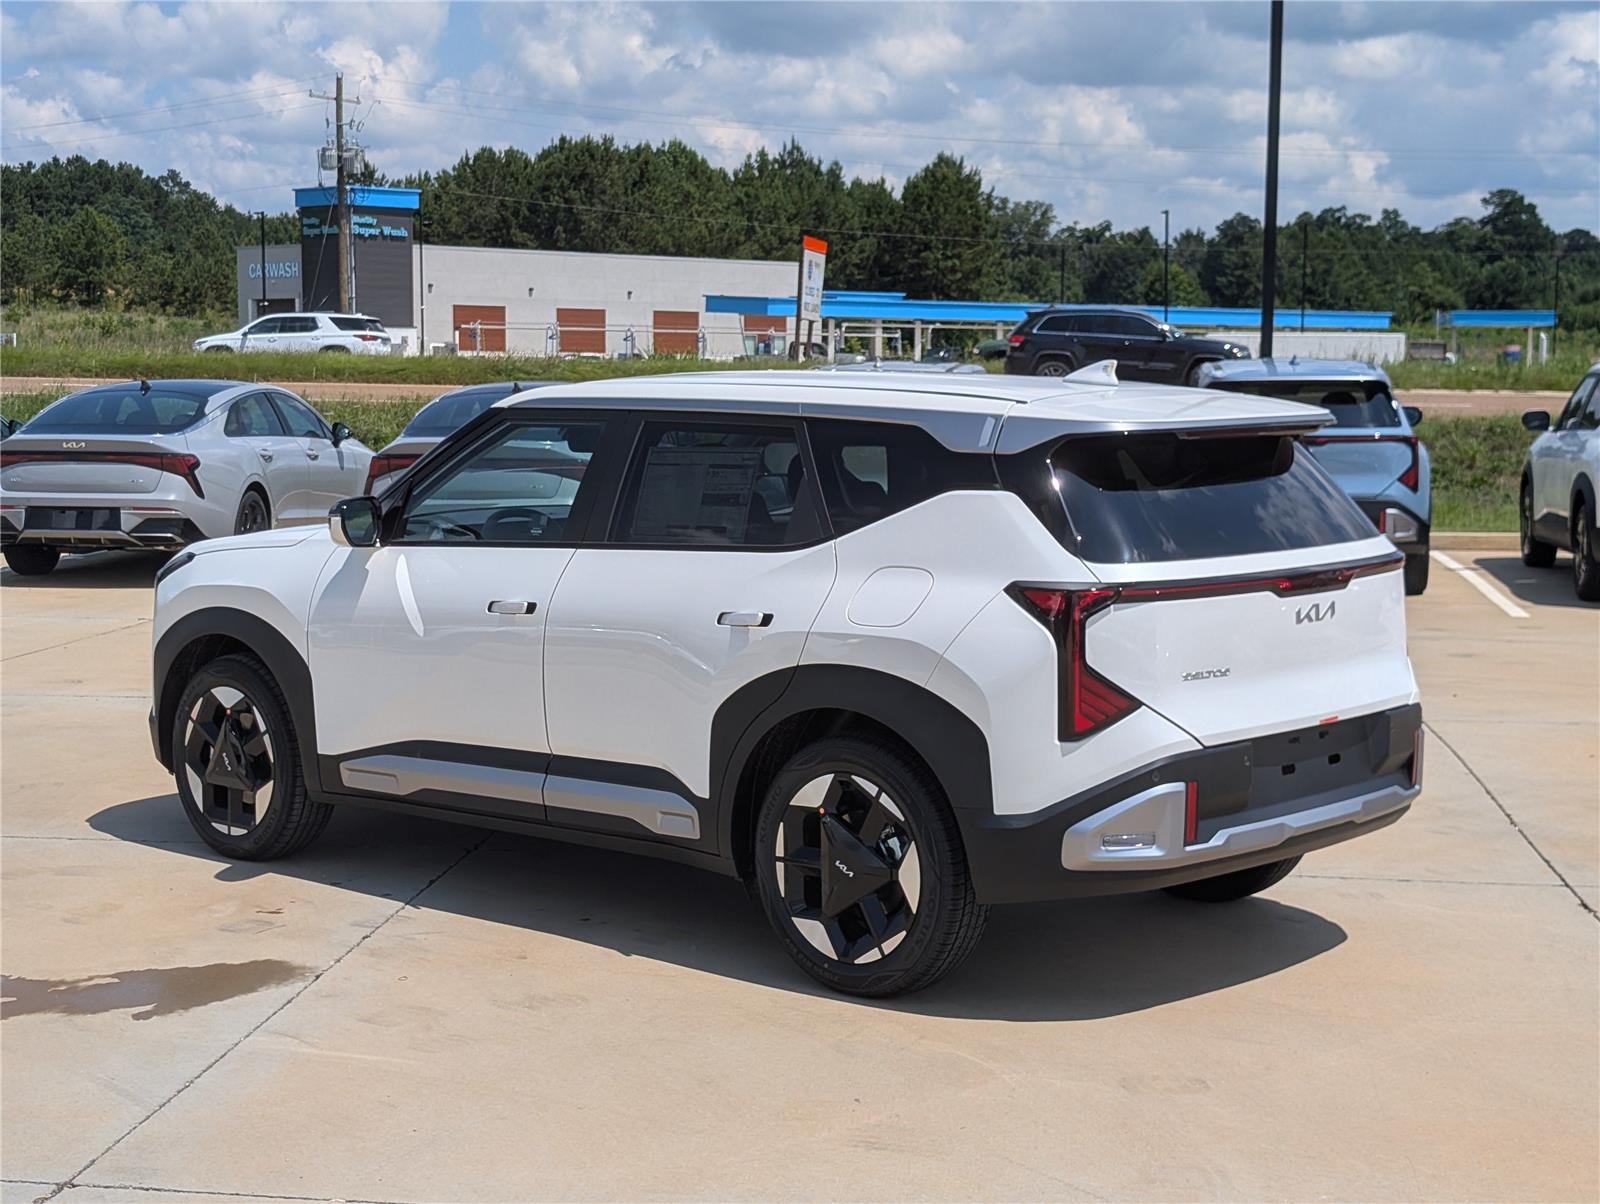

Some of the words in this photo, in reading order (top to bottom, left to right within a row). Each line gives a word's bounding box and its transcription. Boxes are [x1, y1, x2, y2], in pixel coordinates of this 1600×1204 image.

[352, 225, 381, 238] Super
[381, 225, 409, 237] Wash
[248, 262, 299, 279] CARWASH
[62, 441, 85, 449] KIA
[1295, 600, 1336, 625] KIA
[835, 860, 855, 878] KIA
